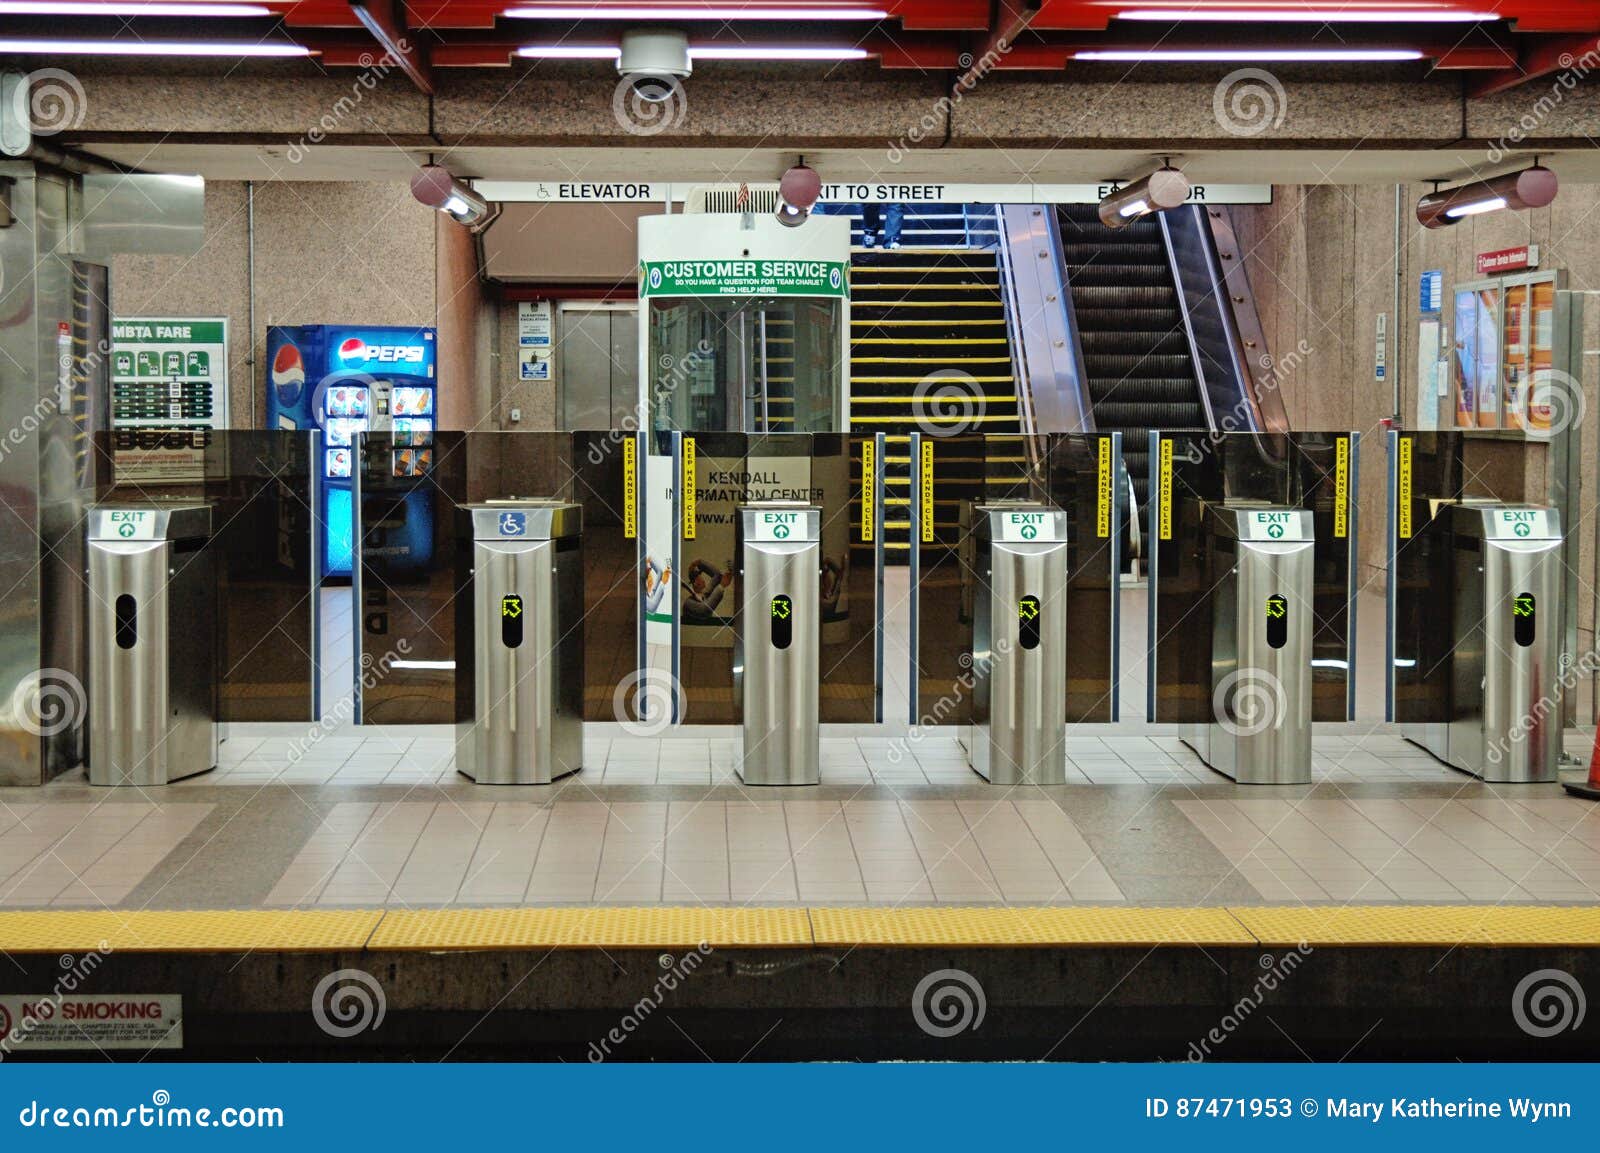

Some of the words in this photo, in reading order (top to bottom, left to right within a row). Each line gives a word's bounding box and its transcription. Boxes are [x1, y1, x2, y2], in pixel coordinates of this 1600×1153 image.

[559, 184, 650, 199] ELEVATOR
[846, 185, 869, 199] TO
[876, 185, 944, 199] STREET
[664, 263, 756, 278] CUSTOMER
[762, 263, 828, 278] SERVICE
[113, 326, 152, 338] MBTA
[157, 326, 192, 338] FARE
[364, 345, 425, 362] PEPSI
[708, 472, 781, 484] KENDALL
[771, 489, 825, 503] CENTER
[112, 511, 146, 522] EXIT
[765, 513, 797, 524] EXIT
[1011, 513, 1045, 524] EXIT
[1257, 512, 1291, 523] EXIT
[1503, 511, 1537, 522] EXIT
[22, 1003, 54, 1020] NO
[62, 1003, 162, 1020] SMOKING
